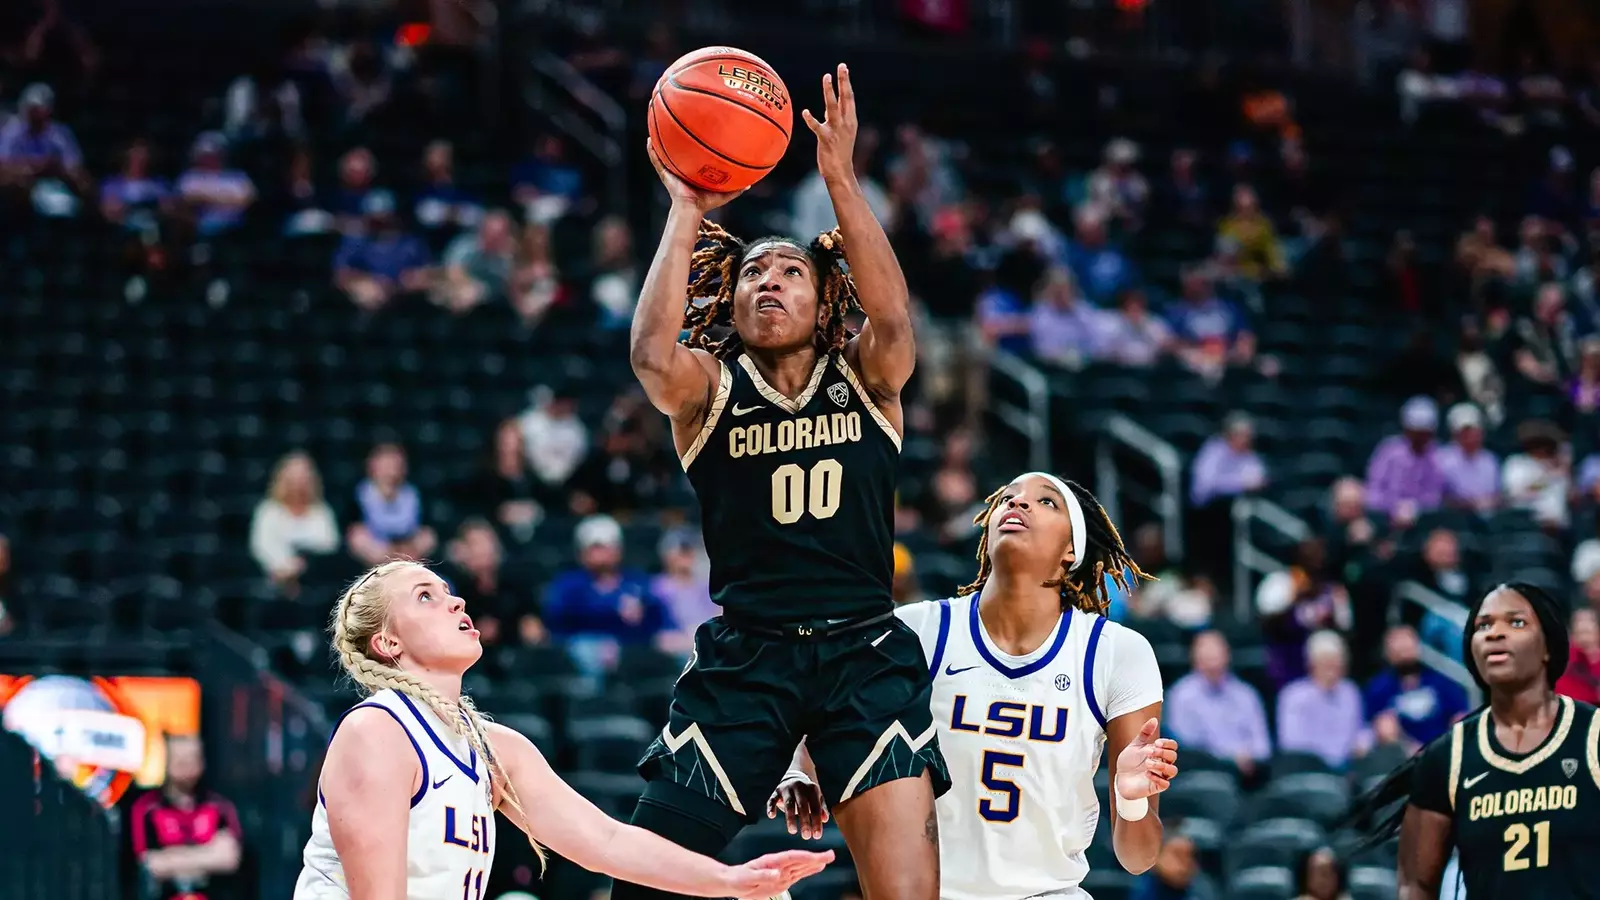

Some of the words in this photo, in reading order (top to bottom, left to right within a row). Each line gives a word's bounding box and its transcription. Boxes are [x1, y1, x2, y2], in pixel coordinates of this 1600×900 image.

[729, 412, 862, 458] COLORADO
[772, 458, 843, 524] 00
[949, 694, 1069, 743] LSU
[977, 749, 1026, 824] 5
[1469, 785, 1577, 821] COLORADO
[1504, 821, 1550, 872] 21
